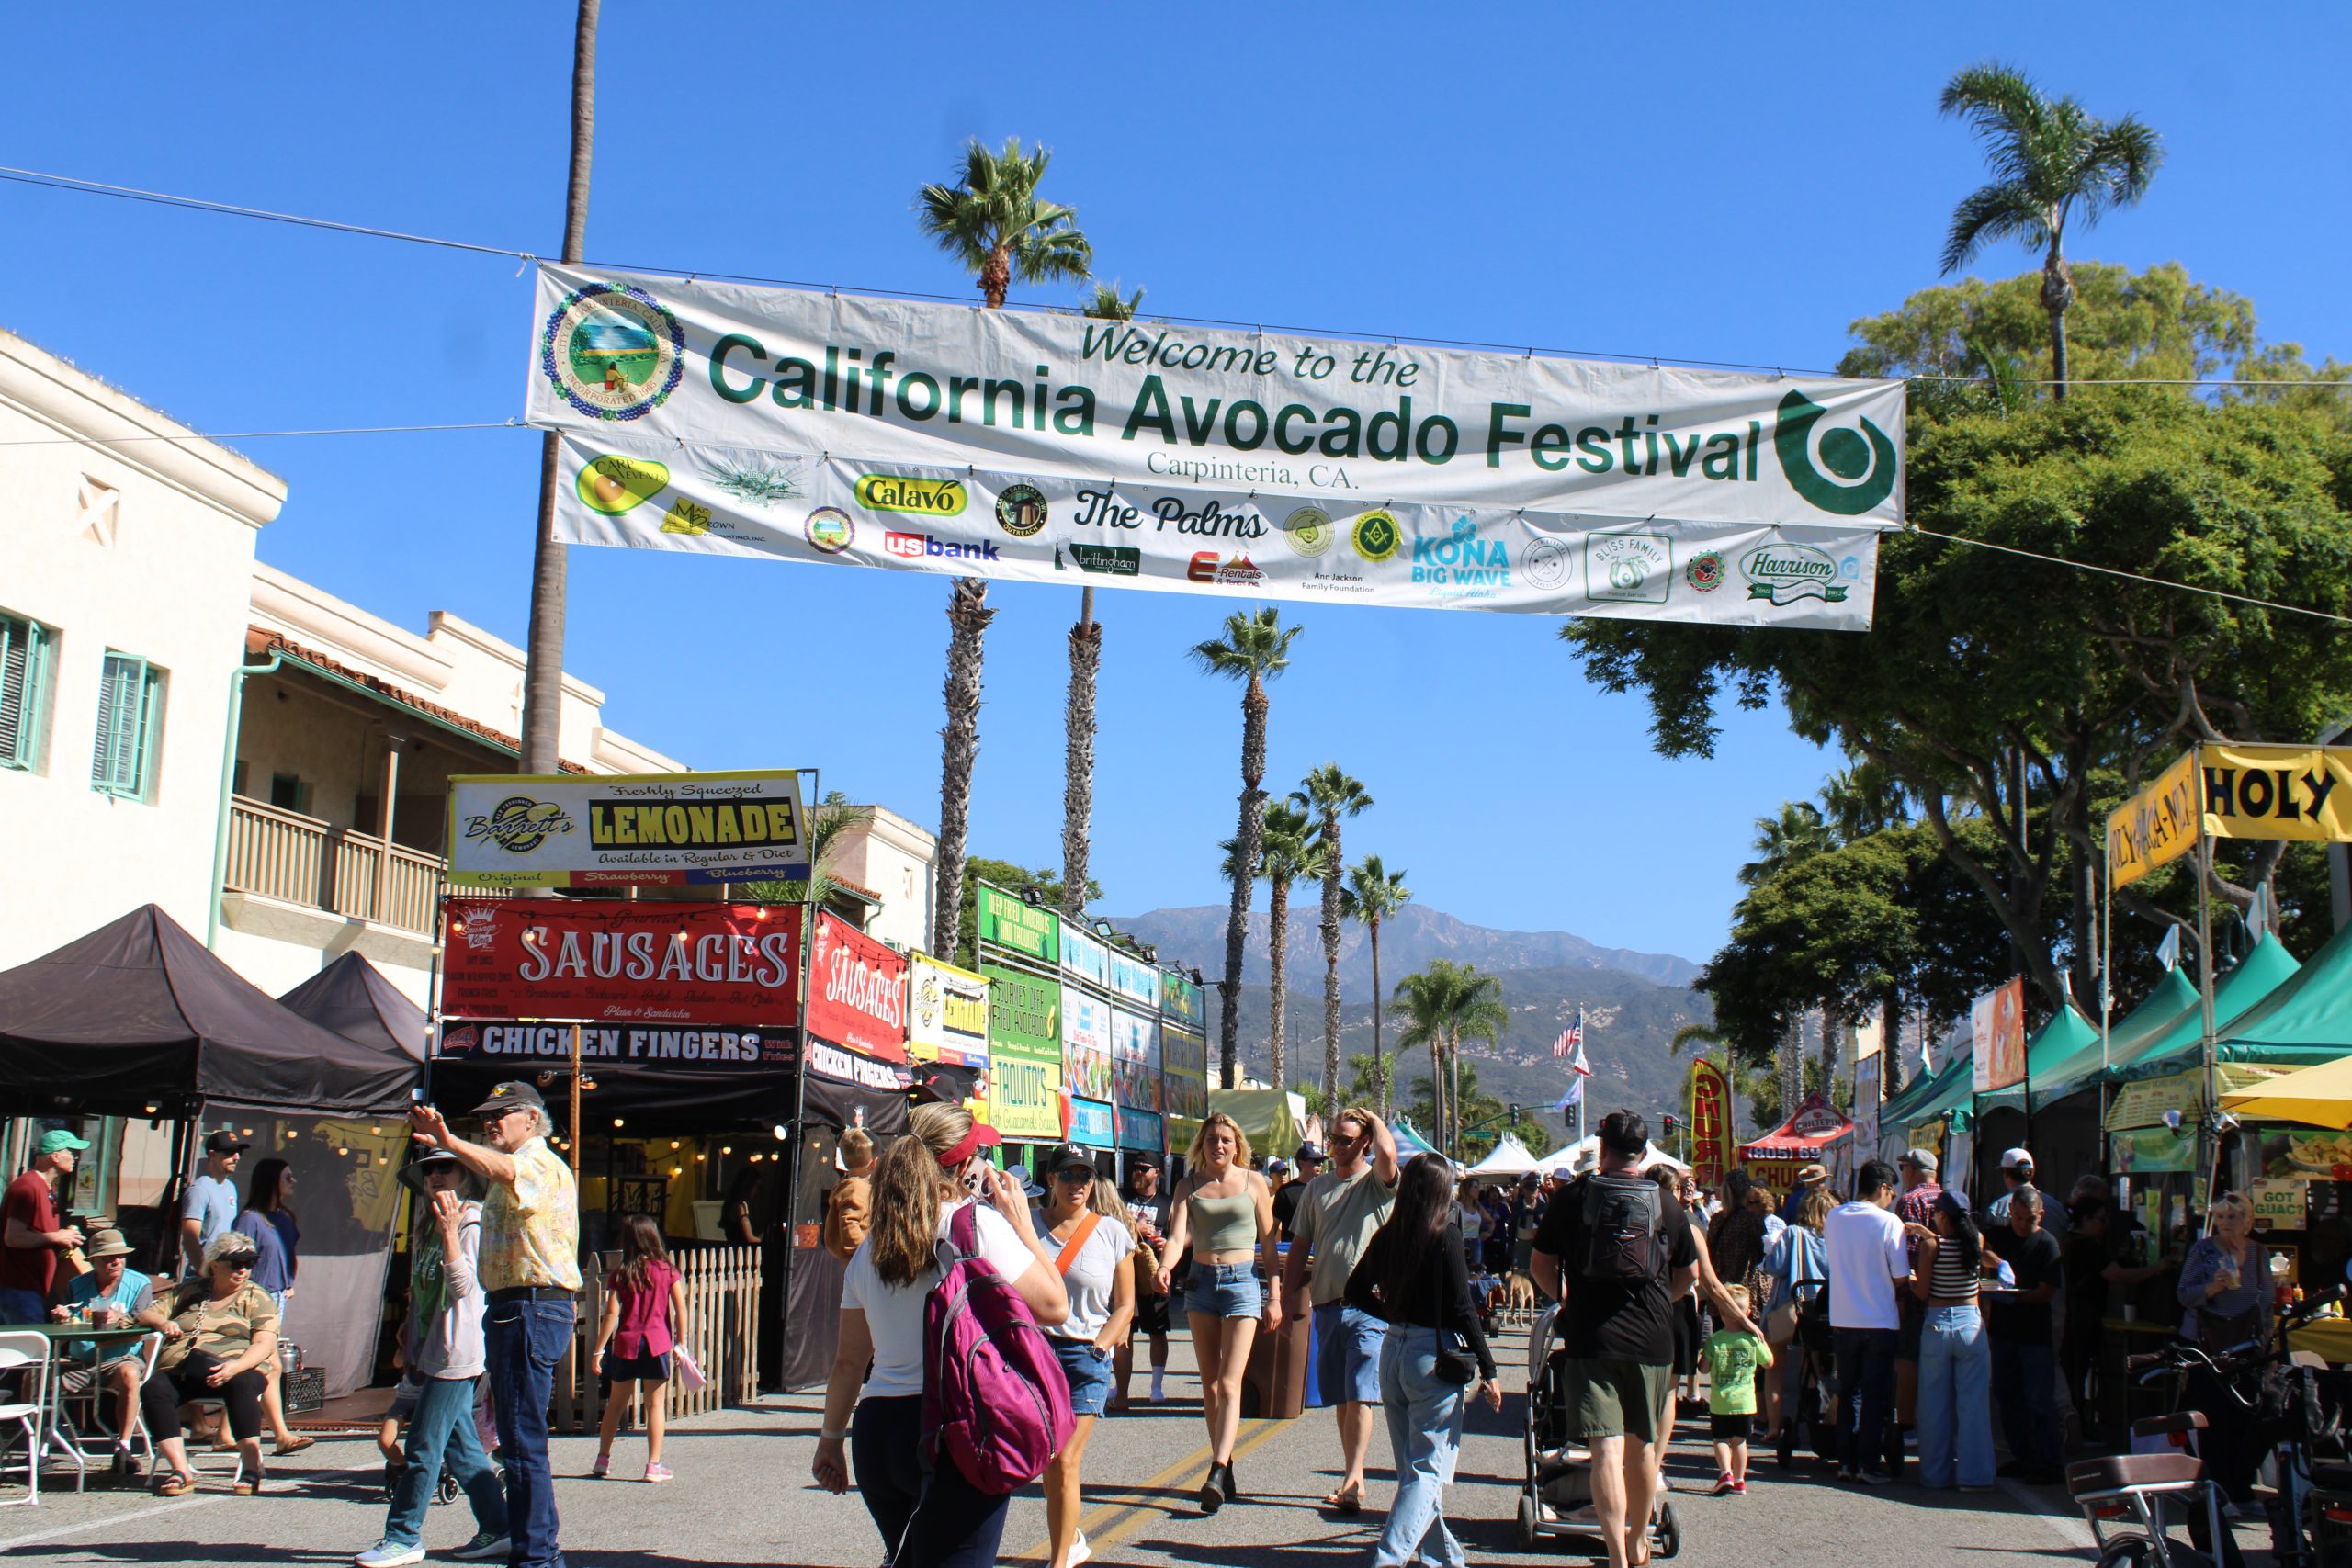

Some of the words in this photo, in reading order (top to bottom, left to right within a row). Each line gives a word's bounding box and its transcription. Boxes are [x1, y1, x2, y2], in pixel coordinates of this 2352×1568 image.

[558, 330, 570, 355] CITY
[565, 318, 576, 331] OF
[643, 309, 671, 364] CALIFORNIA
[1081, 323, 1279, 378] Welcome
[1293, 348, 1336, 380] to
[1350, 351, 1419, 388] the
[565, 372, 637, 406] INCORPORATED
[639, 380, 658, 397] 1965
[708, 333, 1095, 438] California
[1121, 375, 1459, 467] Avocado
[1487, 400, 1758, 484] Festival
[595, 457, 635, 479] CARP
[626, 470, 667, 484] EVENTS
[1147, 450, 1300, 491] Carpinteria,
[1308, 465, 1360, 491] CA.
[1074, 490, 1144, 530] The
[1152, 496, 1269, 539] Palms
[1003, 524, 1039, 536] OUTREACH
[1079, 547, 1136, 573] brittingham
[1412, 534, 1510, 569] KONA
[1629, 538, 1663, 563] FAMILY
[1315, 572, 1330, 581] Ann
[1331, 573, 1363, 582] Jackson
[1411, 566, 1448, 585] BIG
[1453, 569, 1512, 587] WAVE
[1748, 553, 1833, 578] Harrison
[1302, 582, 1329, 592] Family
[1329, 584, 1375, 593] Foundation
[608, 785, 677, 800] Freshly
[681, 784, 763, 799] Squeezed
[2204, 766, 2337, 824] HOLY
[464, 811, 575, 839] Barrett's
[591, 804, 796, 845] LEMONADE
[598, 853, 662, 864] Available
[664, 854, 679, 864] in
[681, 852, 739, 867] Regular
[742, 851, 756, 862] &
[758, 848, 796, 860] Diet
[478, 872, 543, 885] Original
[582, 872, 671, 886] Strawberry
[705, 868, 786, 879] Blueberry
[989, 893, 1004, 917] DEEP
[1003, 897, 1021, 923] FRIED
[1022, 904, 1051, 935] AVOCADOS
[460, 924, 497, 936] Sausage
[1000, 919, 1013, 942] AND
[1012, 924, 1040, 953] TAQUITOS
[517, 925, 789, 988] SAUSAGES
[826, 947, 901, 1030] SAUSAGES
[1029, 987, 1046, 1011] DEEP
[992, 1004, 1012, 1032] FRIED
[1014, 1010, 1048, 1039] AVOCADOS
[482, 1025, 621, 1056] CHICKEN
[629, 1030, 761, 1062] FINGERS
[812, 1041, 854, 1083] CHICKEN
[854, 1055, 901, 1090] FINGERS
[997, 1060, 1047, 1108] TAQUITO'S
[1003, 1109, 1038, 1132] Guacamole
[1038, 1111, 1057, 1132] Sauce
[1794, 1115, 1842, 1132] CHILTEPIN
[1747, 1145, 1792, 1159] (805)
[2255, 1203, 2305, 1215] GUAC?
[2264, 1191, 2295, 1203] GOT
